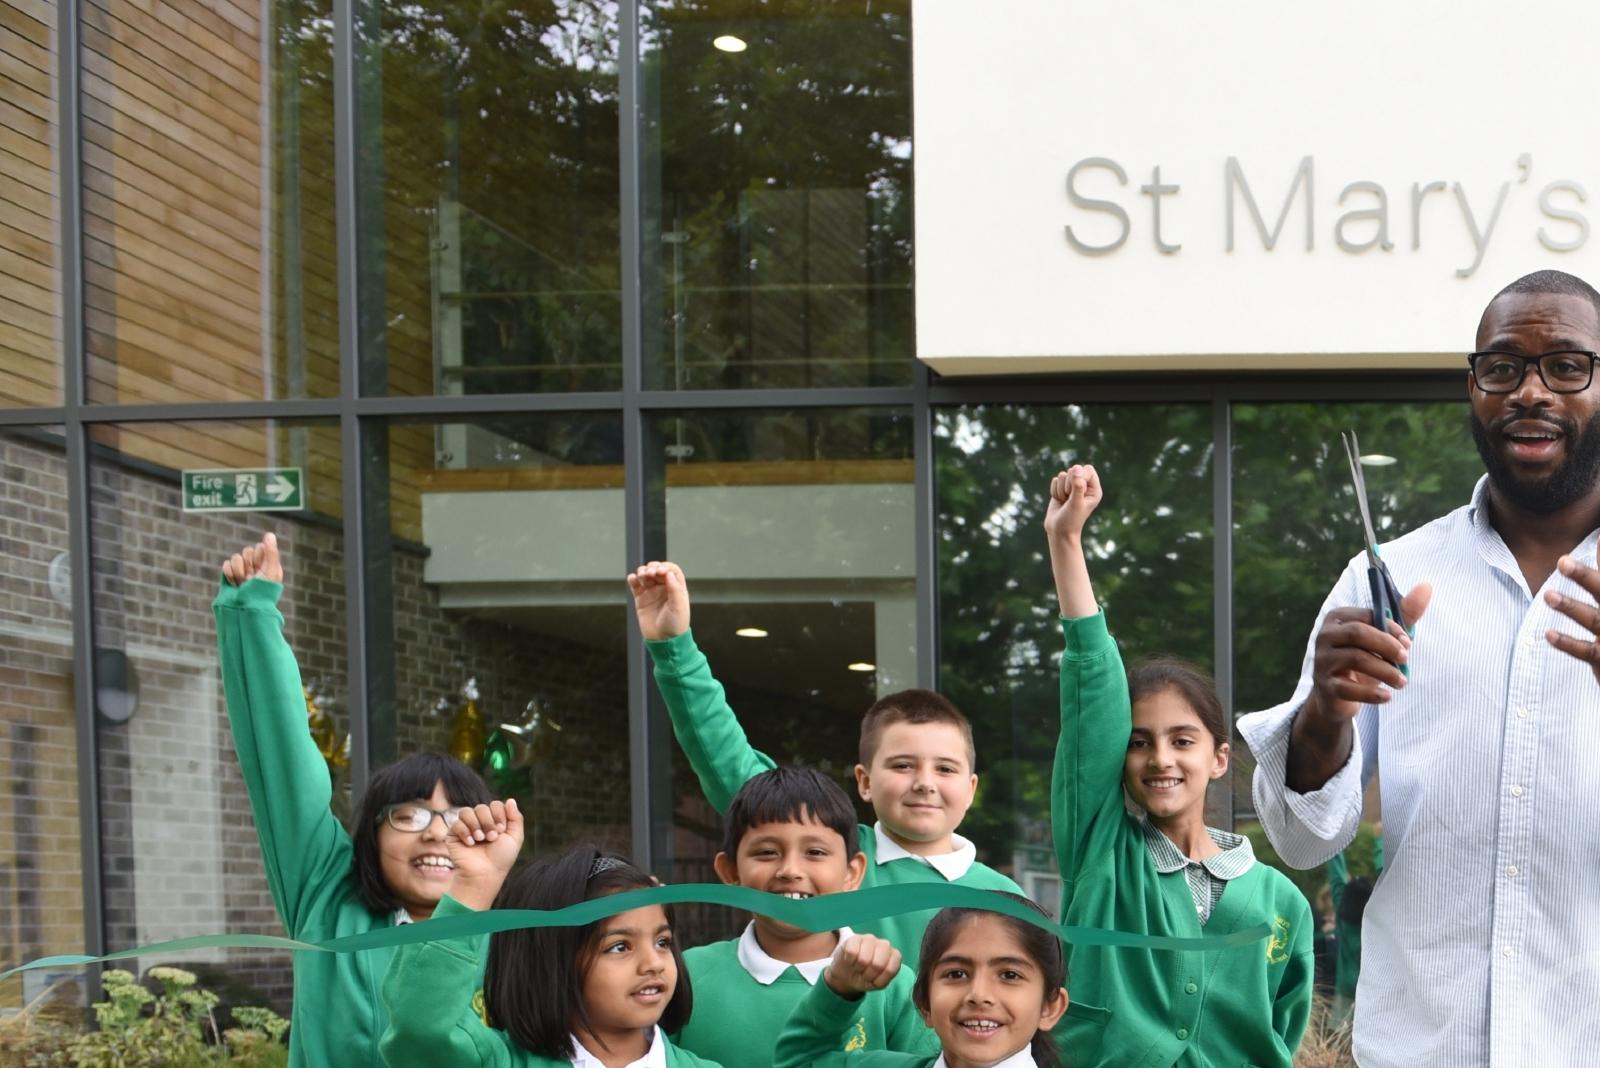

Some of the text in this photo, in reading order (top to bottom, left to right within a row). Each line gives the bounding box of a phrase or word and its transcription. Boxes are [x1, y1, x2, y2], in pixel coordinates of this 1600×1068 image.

[1064, 156, 1182, 257] St
[192, 474, 223, 490] Fire
[192, 490, 223, 507] exit
